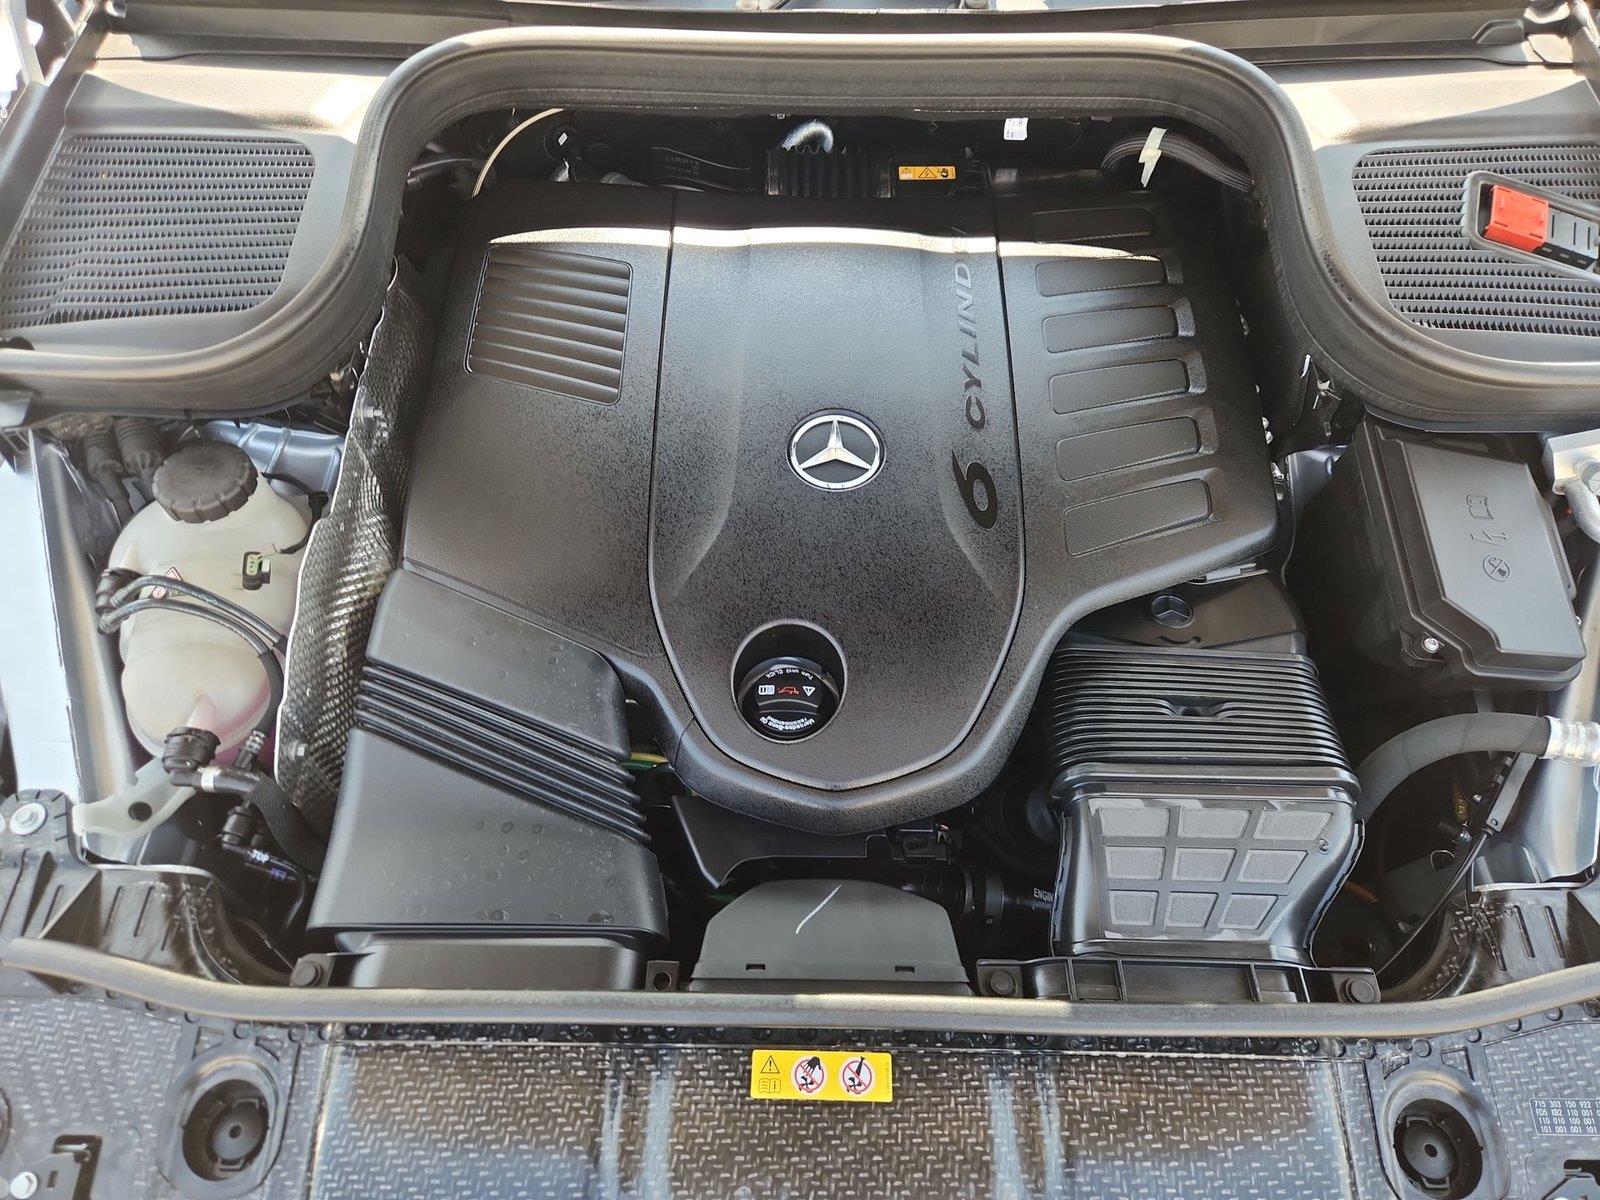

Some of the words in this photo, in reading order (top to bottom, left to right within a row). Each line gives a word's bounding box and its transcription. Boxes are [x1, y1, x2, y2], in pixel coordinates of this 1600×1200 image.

[951, 232, 986, 430] CYLIND
[951, 451, 999, 531] 6
[765, 669, 784, 680] CLICK
[800, 671, 814, 681] Turn
[1534, 1100, 1547, 1108] 715
[1549, 1100, 1562, 1108] 303
[1565, 1100, 1577, 1108] 150
[1539, 1117, 1551, 1125] 110
[1553, 1117, 1566, 1125] 010
